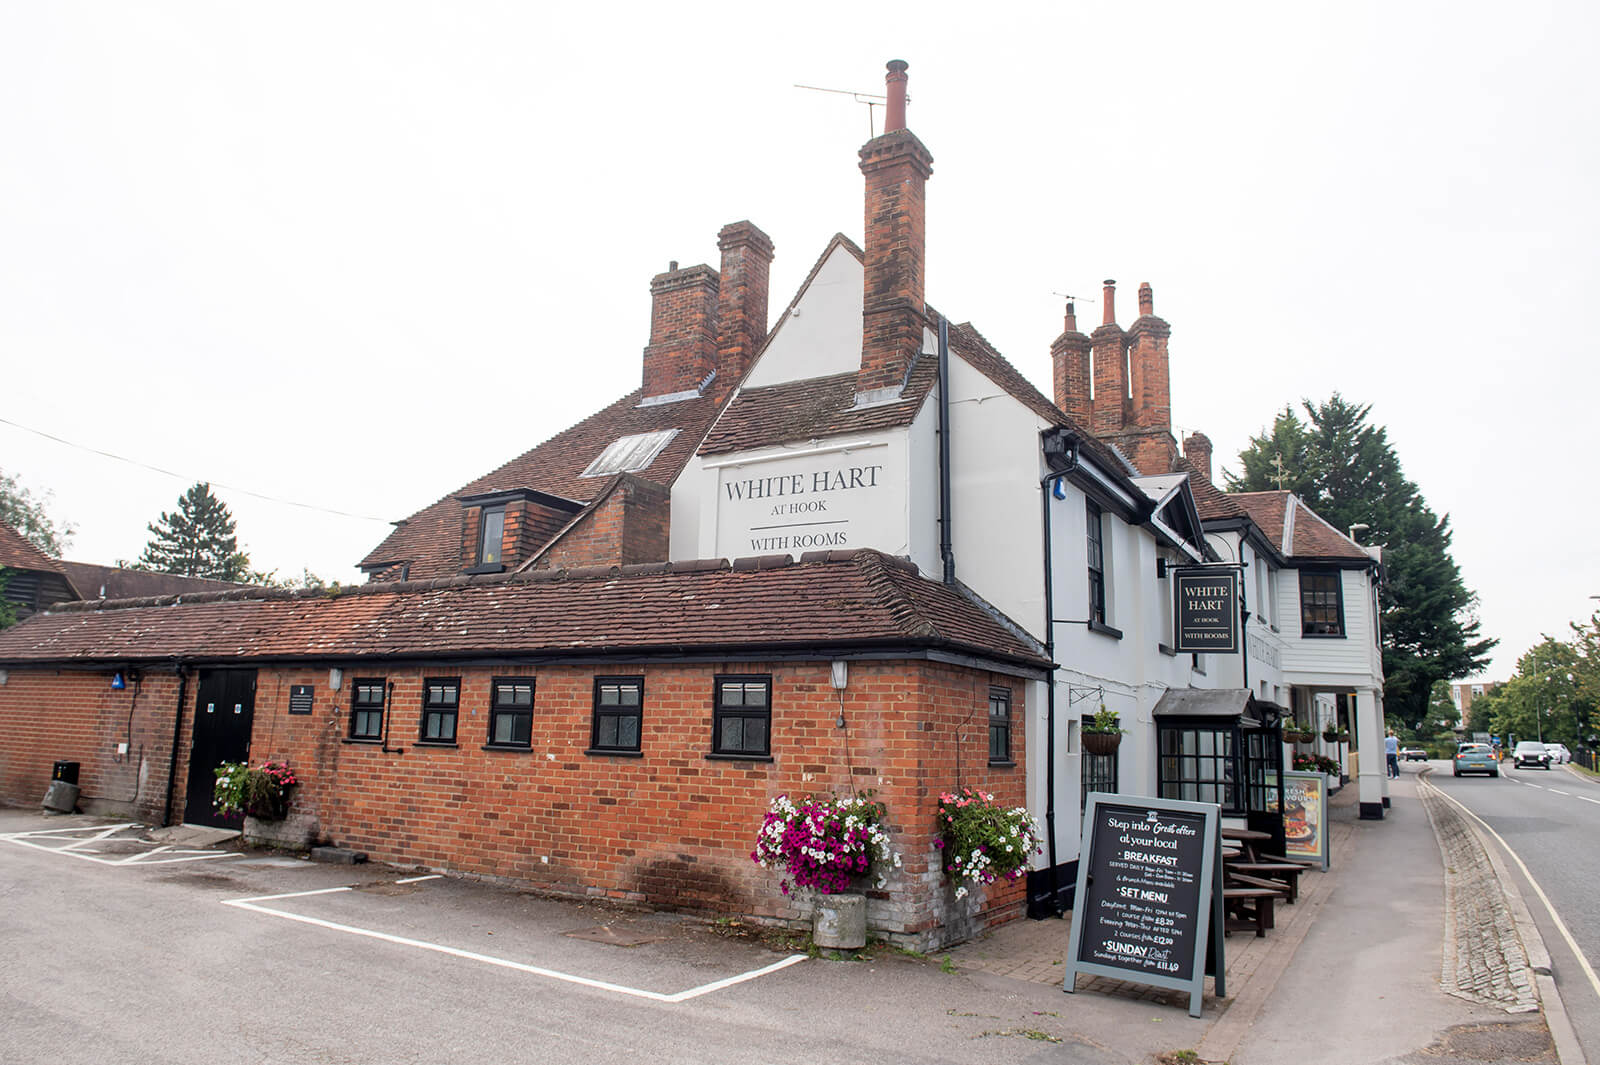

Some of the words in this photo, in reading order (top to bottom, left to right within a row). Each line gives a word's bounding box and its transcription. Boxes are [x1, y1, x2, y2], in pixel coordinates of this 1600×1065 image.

[726, 474, 804, 501] WHITE
[812, 465, 882, 491] HART
[771, 504, 787, 516] AT
[790, 500, 827, 514] HOOK
[751, 537, 788, 551] WITH
[793, 531, 847, 548] ROOMS
[1185, 586, 1228, 596] WHITE
[1189, 600, 1224, 610] HART
[1108, 817, 1130, 832] Step
[1131, 821, 1150, 831] into
[1153, 822, 1176, 834] Great
[1176, 824, 1196, 836] offers
[1120, 833, 1130, 844] at
[1130, 837, 1153, 847] your
[1154, 837, 1177, 850] local
[1123, 850, 1178, 866] BREAKFAST
[1120, 886, 1140, 899] SET
[1140, 889, 1168, 904] MENU
[1106, 940, 1148, 957] SUNDAY
